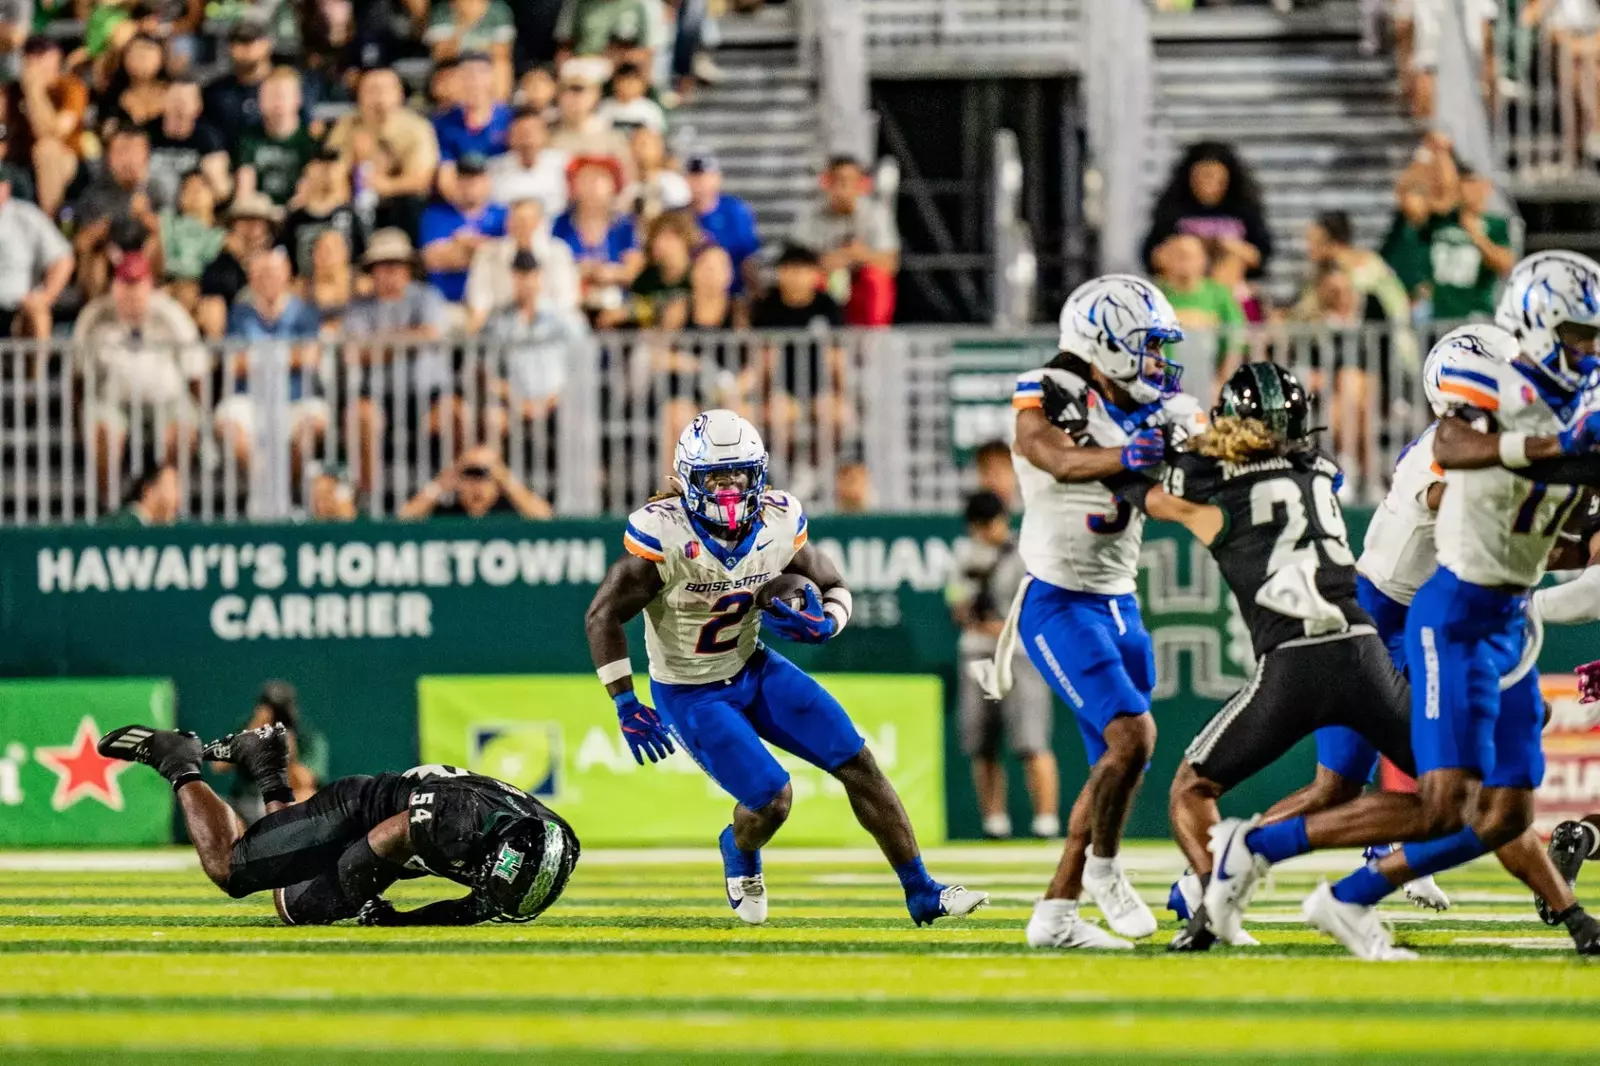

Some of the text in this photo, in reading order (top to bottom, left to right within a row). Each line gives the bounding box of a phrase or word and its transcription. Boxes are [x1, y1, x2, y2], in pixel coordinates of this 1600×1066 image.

[297, 537, 606, 588] HOMETOWN
[684, 571, 770, 593] BOISE STATE
[209, 592, 433, 641] CARRIER
[694, 590, 754, 655] 2
[410, 791, 435, 824] 54
